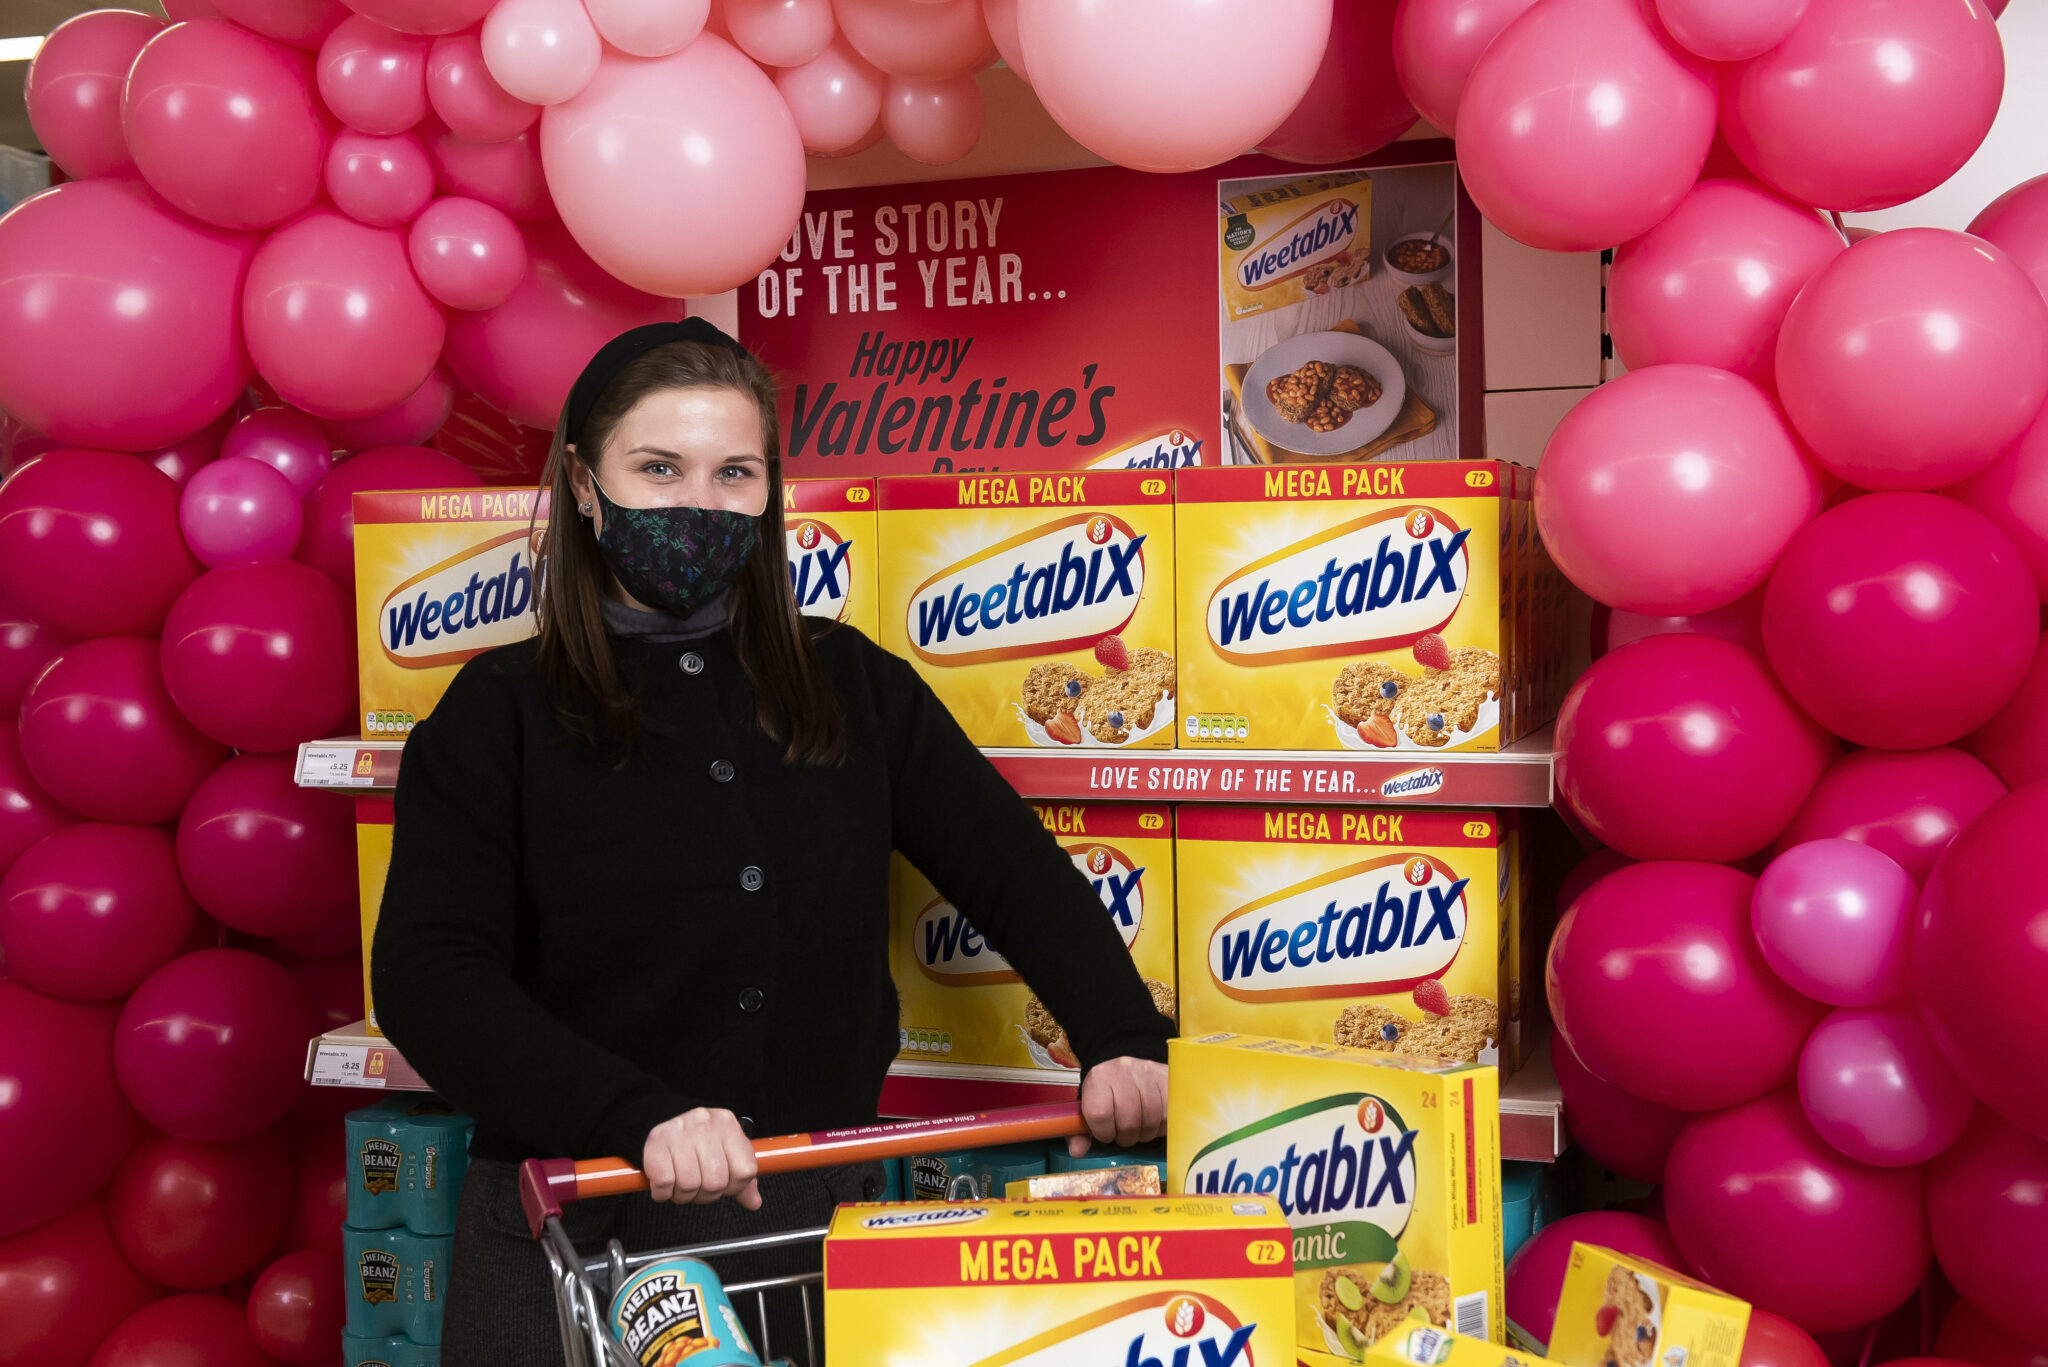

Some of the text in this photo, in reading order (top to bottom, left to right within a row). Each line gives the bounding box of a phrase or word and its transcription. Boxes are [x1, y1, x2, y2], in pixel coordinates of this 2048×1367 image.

[780, 198, 1003, 263] OVE STORY
[1244, 204, 1360, 285] Weetabix
[758, 253, 1066, 318] OF THE YEAR...
[849, 331, 974, 385] Happy
[788, 363, 1116, 459] Valentine's
[959, 477, 1160, 504] MEGA PACK 72
[1265, 468, 1486, 497] MEGA PACK 72
[852, 488, 865, 500] 72
[420, 493, 530, 520] MEGA PACK
[919, 535, 1147, 647] Weetabix
[1220, 528, 1471, 646] Weetabix
[1090, 766, 1376, 793] LOVE STORY OF THE YEAR...
[1382, 770, 1444, 796] Weetabix
[1145, 815, 1157, 827] 72
[1265, 812, 1484, 841] MEGA PACK 72
[1221, 878, 1470, 981] Weetabix
[1421, 1091, 1437, 1108] 24
[1450, 1091, 1461, 1107] 24
[896, 1119, 930, 1130] available
[932, 1117, 953, 1125] seats
[953, 1114, 975, 1123] Child
[826, 1128, 857, 1138] trolleys
[859, 1126, 882, 1134] larger
[367, 1142, 395, 1153] HEINZ
[364, 1155, 398, 1167] BEANZ
[915, 1157, 944, 1172] HEINZ
[913, 1170, 946, 1189] BEANZ
[868, 1208, 988, 1227] Weetabix
[1292, 1224, 1346, 1262] anic
[365, 1253, 393, 1264] HEINZ
[960, 1236, 1275, 1282] MEGA PACK 72
[1573, 1252, 1584, 1270] 12
[362, 1265, 396, 1278] BEANZ
[623, 1276, 675, 1320] HEINZ
[626, 1291, 697, 1353] BEANZ
[654, 1316, 677, 1335] tomato
